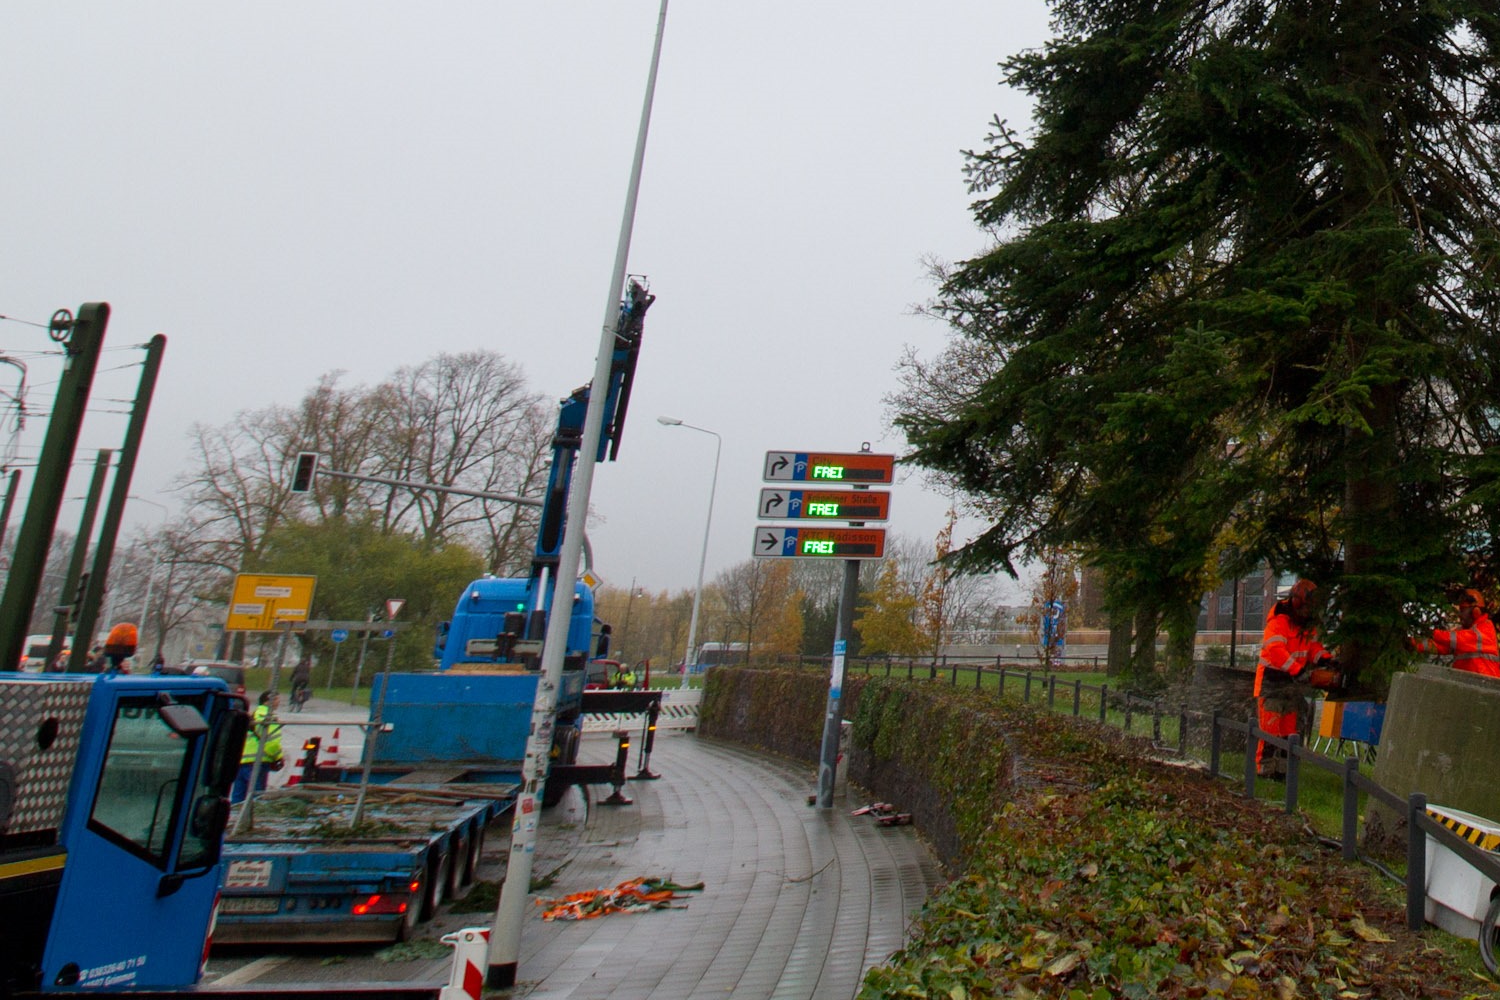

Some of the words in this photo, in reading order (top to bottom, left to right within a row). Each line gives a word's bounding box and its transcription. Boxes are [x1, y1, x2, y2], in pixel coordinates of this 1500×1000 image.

[813, 466, 844, 478] FREI
[808, 503, 839, 515] FREI
[828, 531, 877, 541] Radisson
[803, 541, 835, 553] FREI
